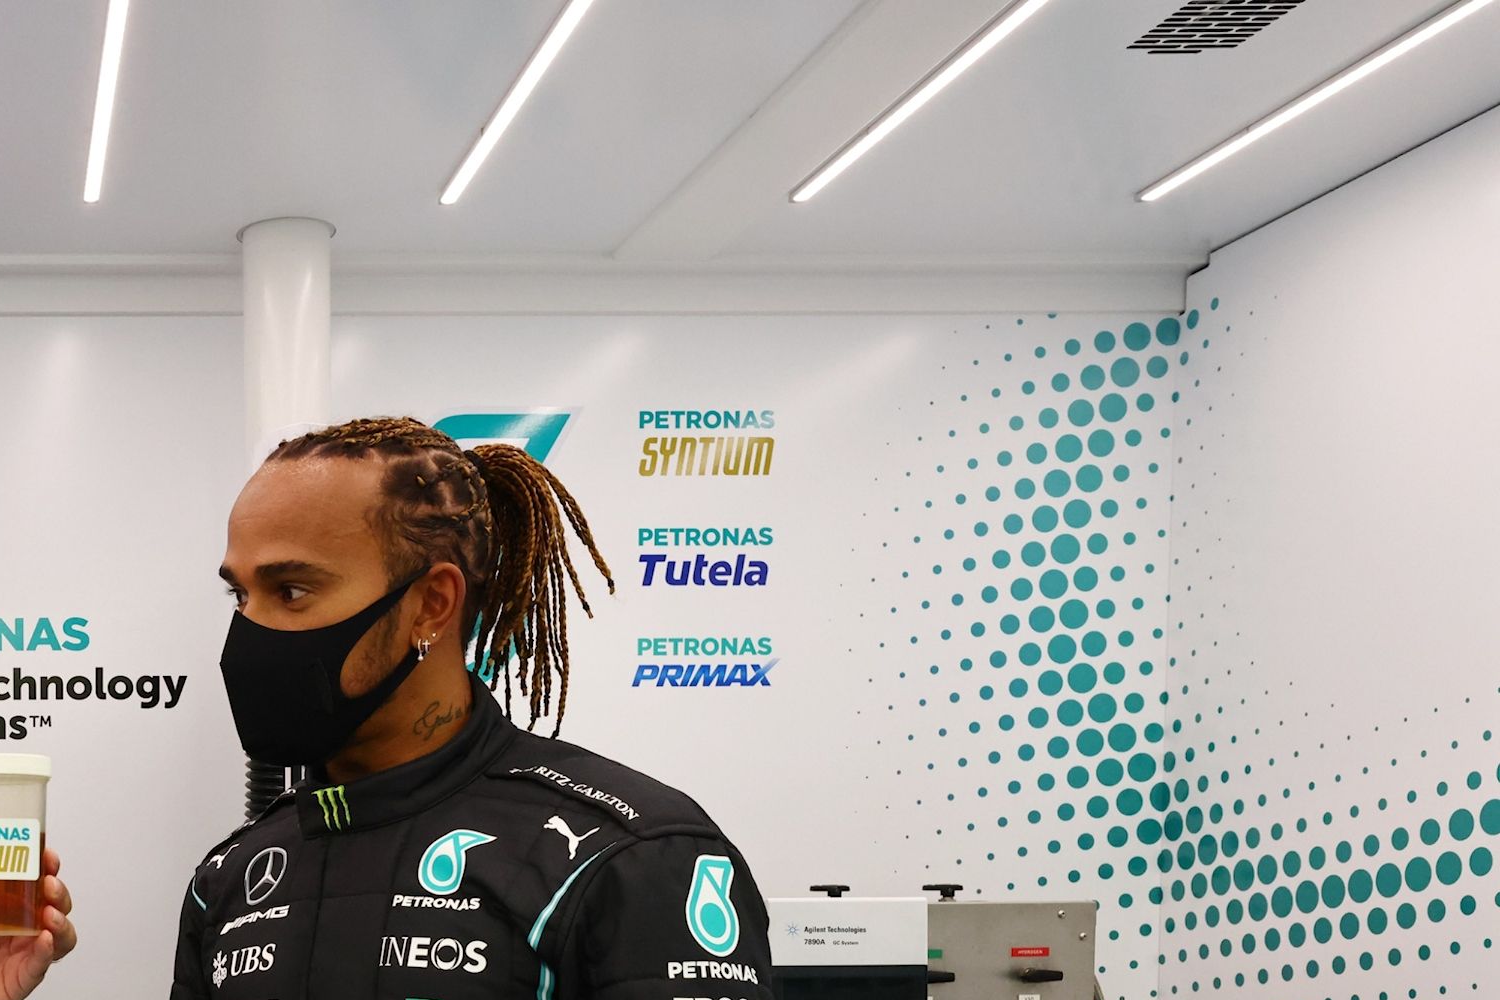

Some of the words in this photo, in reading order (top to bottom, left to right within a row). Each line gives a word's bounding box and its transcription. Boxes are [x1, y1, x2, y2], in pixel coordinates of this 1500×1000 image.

[639, 410, 775, 429] PETRONAS
[638, 437, 775, 477] SYNTIUM
[638, 527, 773, 546] PETRONAS
[638, 554, 769, 587] Tutela
[637, 637, 772, 656] PETRONAS
[631, 657, 781, 687] PRIMAX
[392, 895, 480, 911] PETRONAS
[804, 926, 826, 934] Agilent
[828, 926, 866, 934] Technologies
[231, 943, 276, 977] UBS
[379, 936, 487, 973] INEOS
[667, 961, 759, 985] PETRONAS
